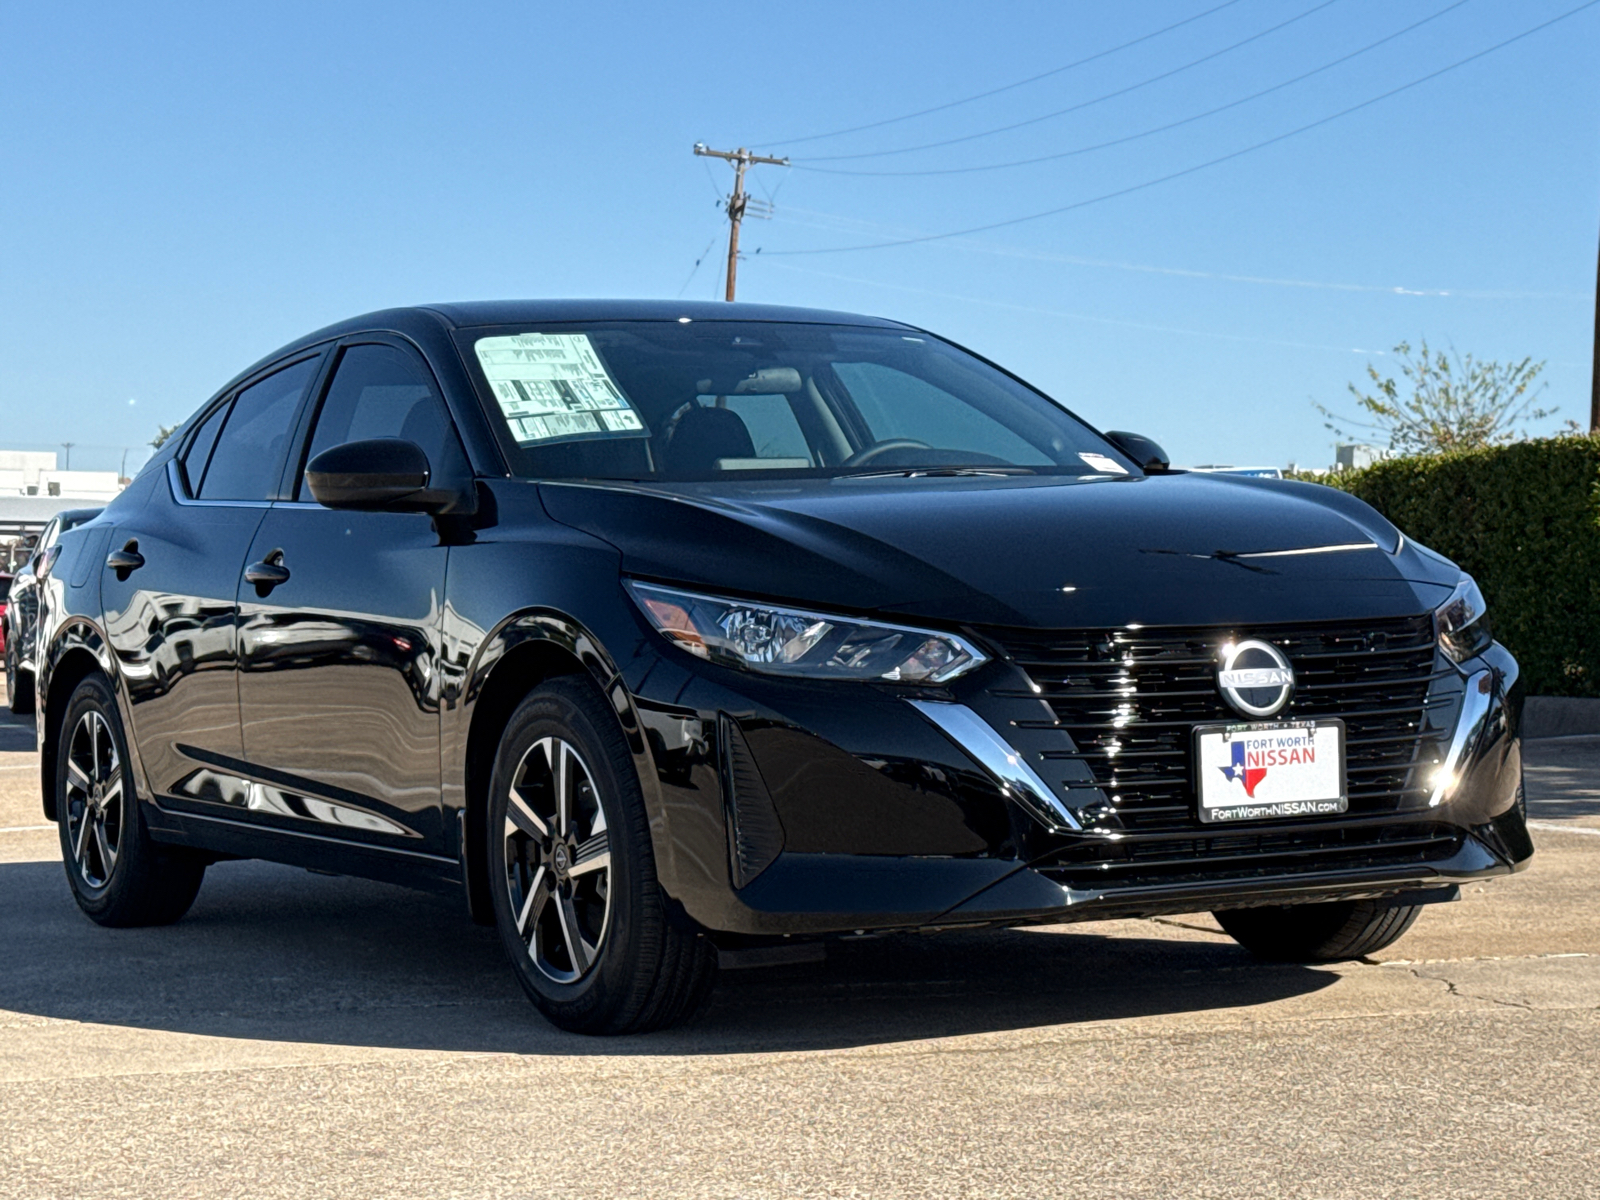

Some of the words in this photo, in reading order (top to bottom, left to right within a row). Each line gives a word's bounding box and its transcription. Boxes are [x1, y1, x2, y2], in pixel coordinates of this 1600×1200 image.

[1223, 671, 1292, 685] NISSAN
[1226, 724, 1248, 733] FORT
[1250, 722, 1279, 731] WORTH
[1291, 720, 1316, 728] TEXAS
[1246, 738, 1274, 749] FORT
[1276, 736, 1315, 748] WORTH
[1247, 747, 1315, 767] NISSAN
